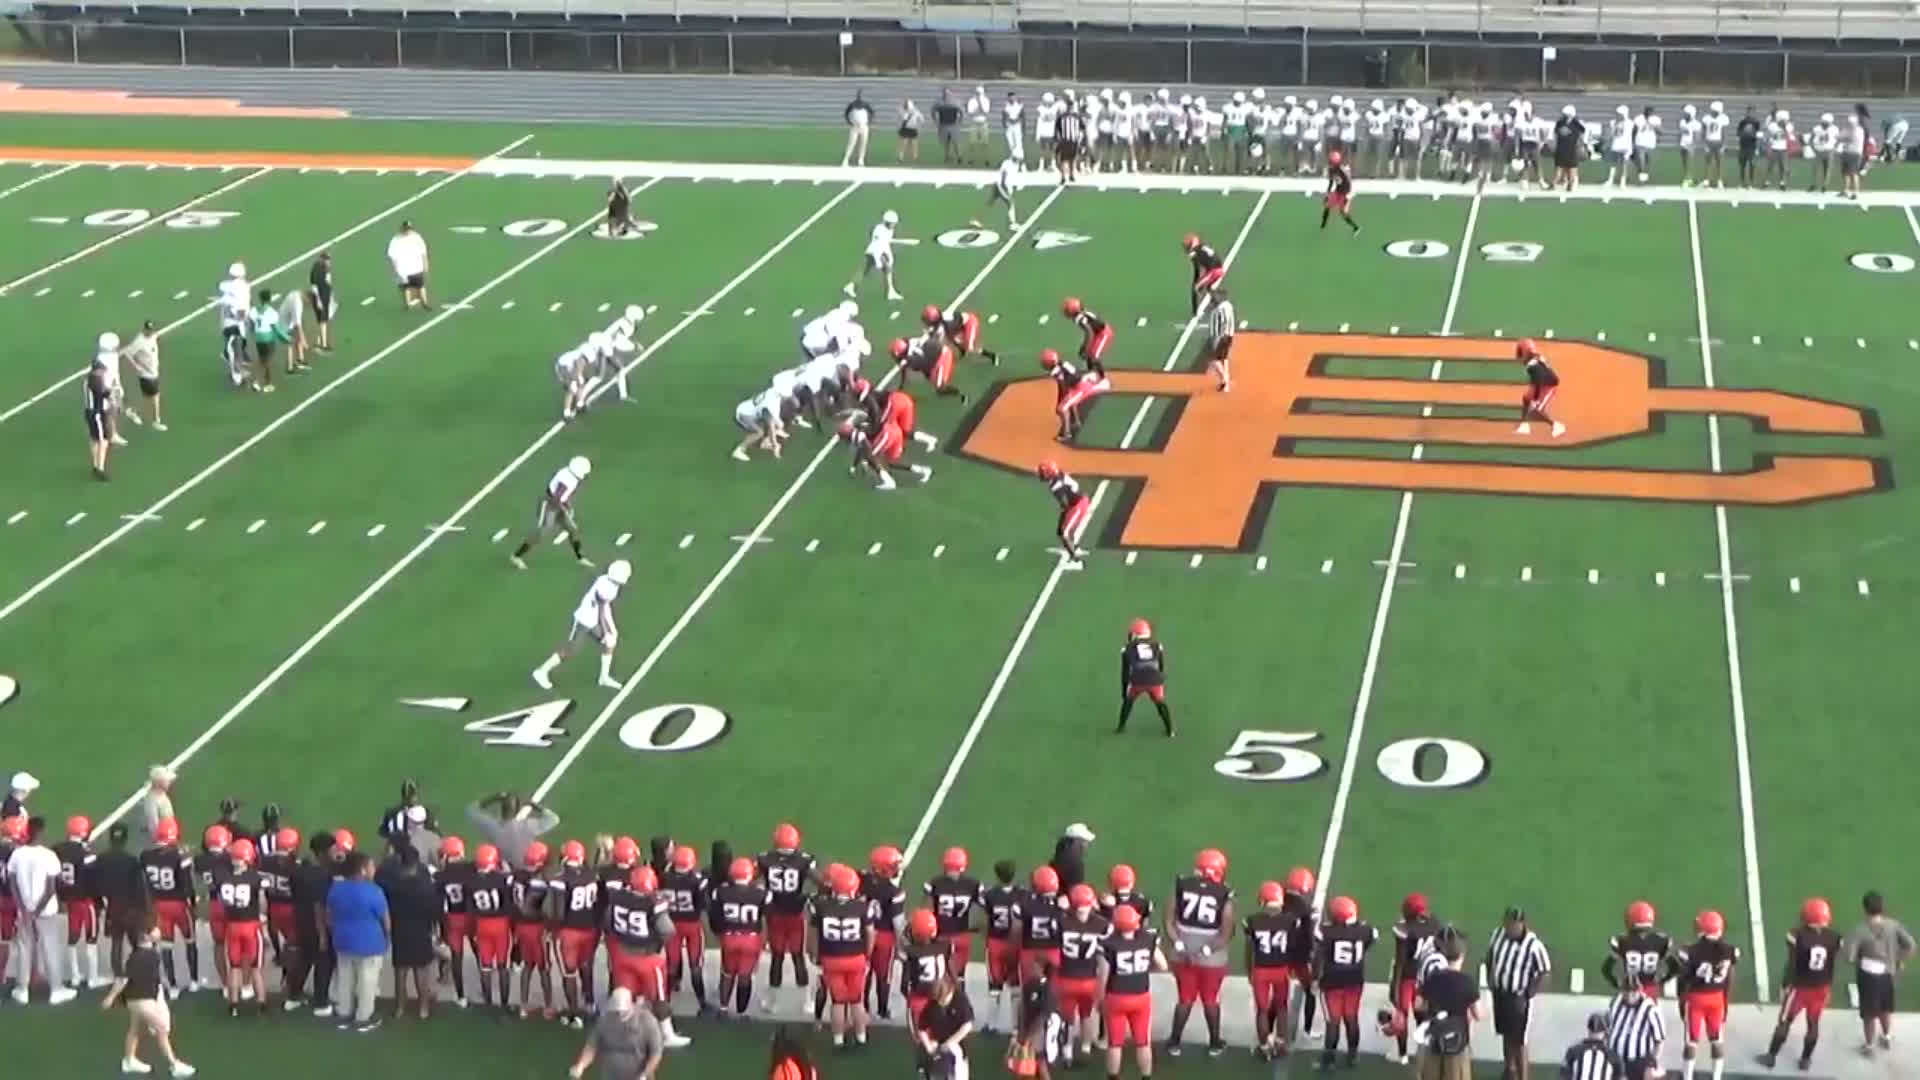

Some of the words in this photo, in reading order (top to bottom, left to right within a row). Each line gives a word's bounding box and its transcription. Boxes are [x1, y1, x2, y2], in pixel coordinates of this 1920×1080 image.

[145, 865, 176, 891] 28
[767, 867, 799, 892] 58
[473, 888, 500, 911] 81
[1181, 891, 1218, 924] 76
[614, 904, 650, 937] 59
[822, 915, 862, 942] 62
[1062, 932, 1098, 959] 57
[1333, 939, 1364, 965] 61
[918, 953, 946, 983] 31
[1116, 949, 1150, 976] 56
